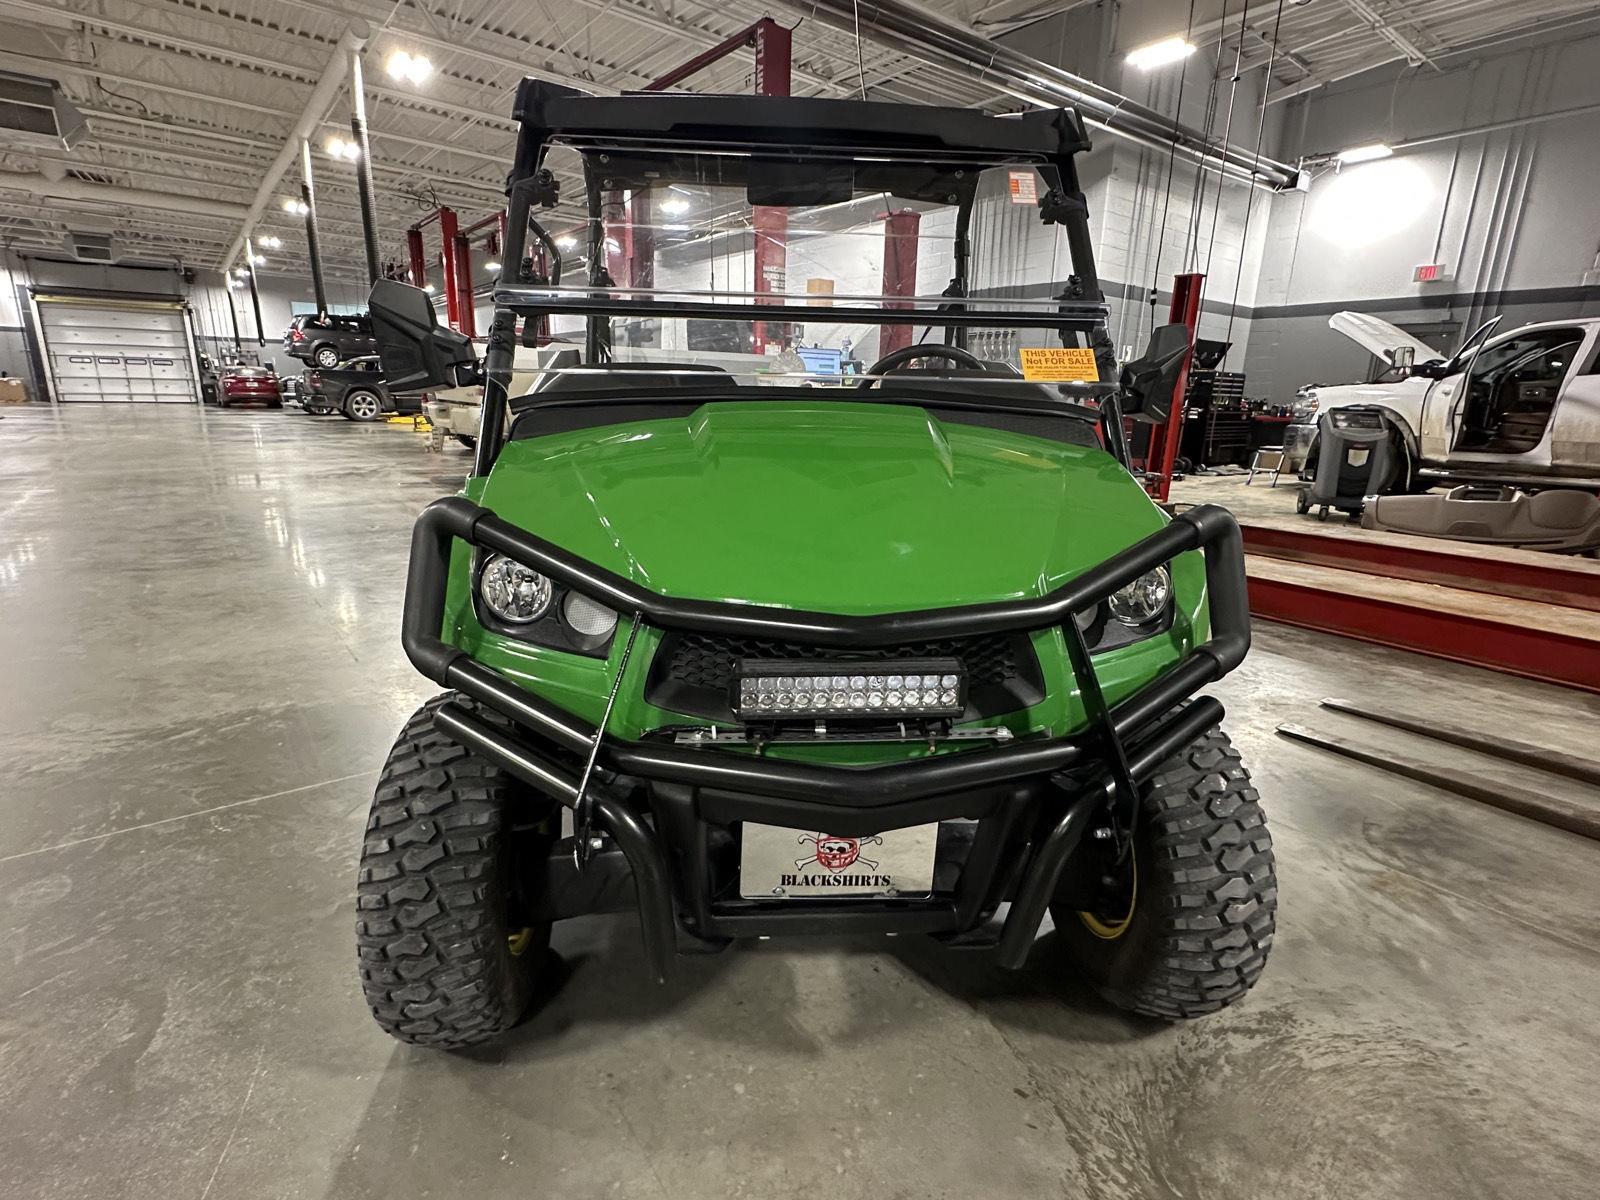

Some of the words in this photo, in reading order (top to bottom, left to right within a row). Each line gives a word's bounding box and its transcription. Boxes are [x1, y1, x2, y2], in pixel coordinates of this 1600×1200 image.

[757, 27, 765, 60] LIFT
[1418, 266, 1437, 280] EXIT
[780, 874, 892, 887] BLACKSHIRTS
